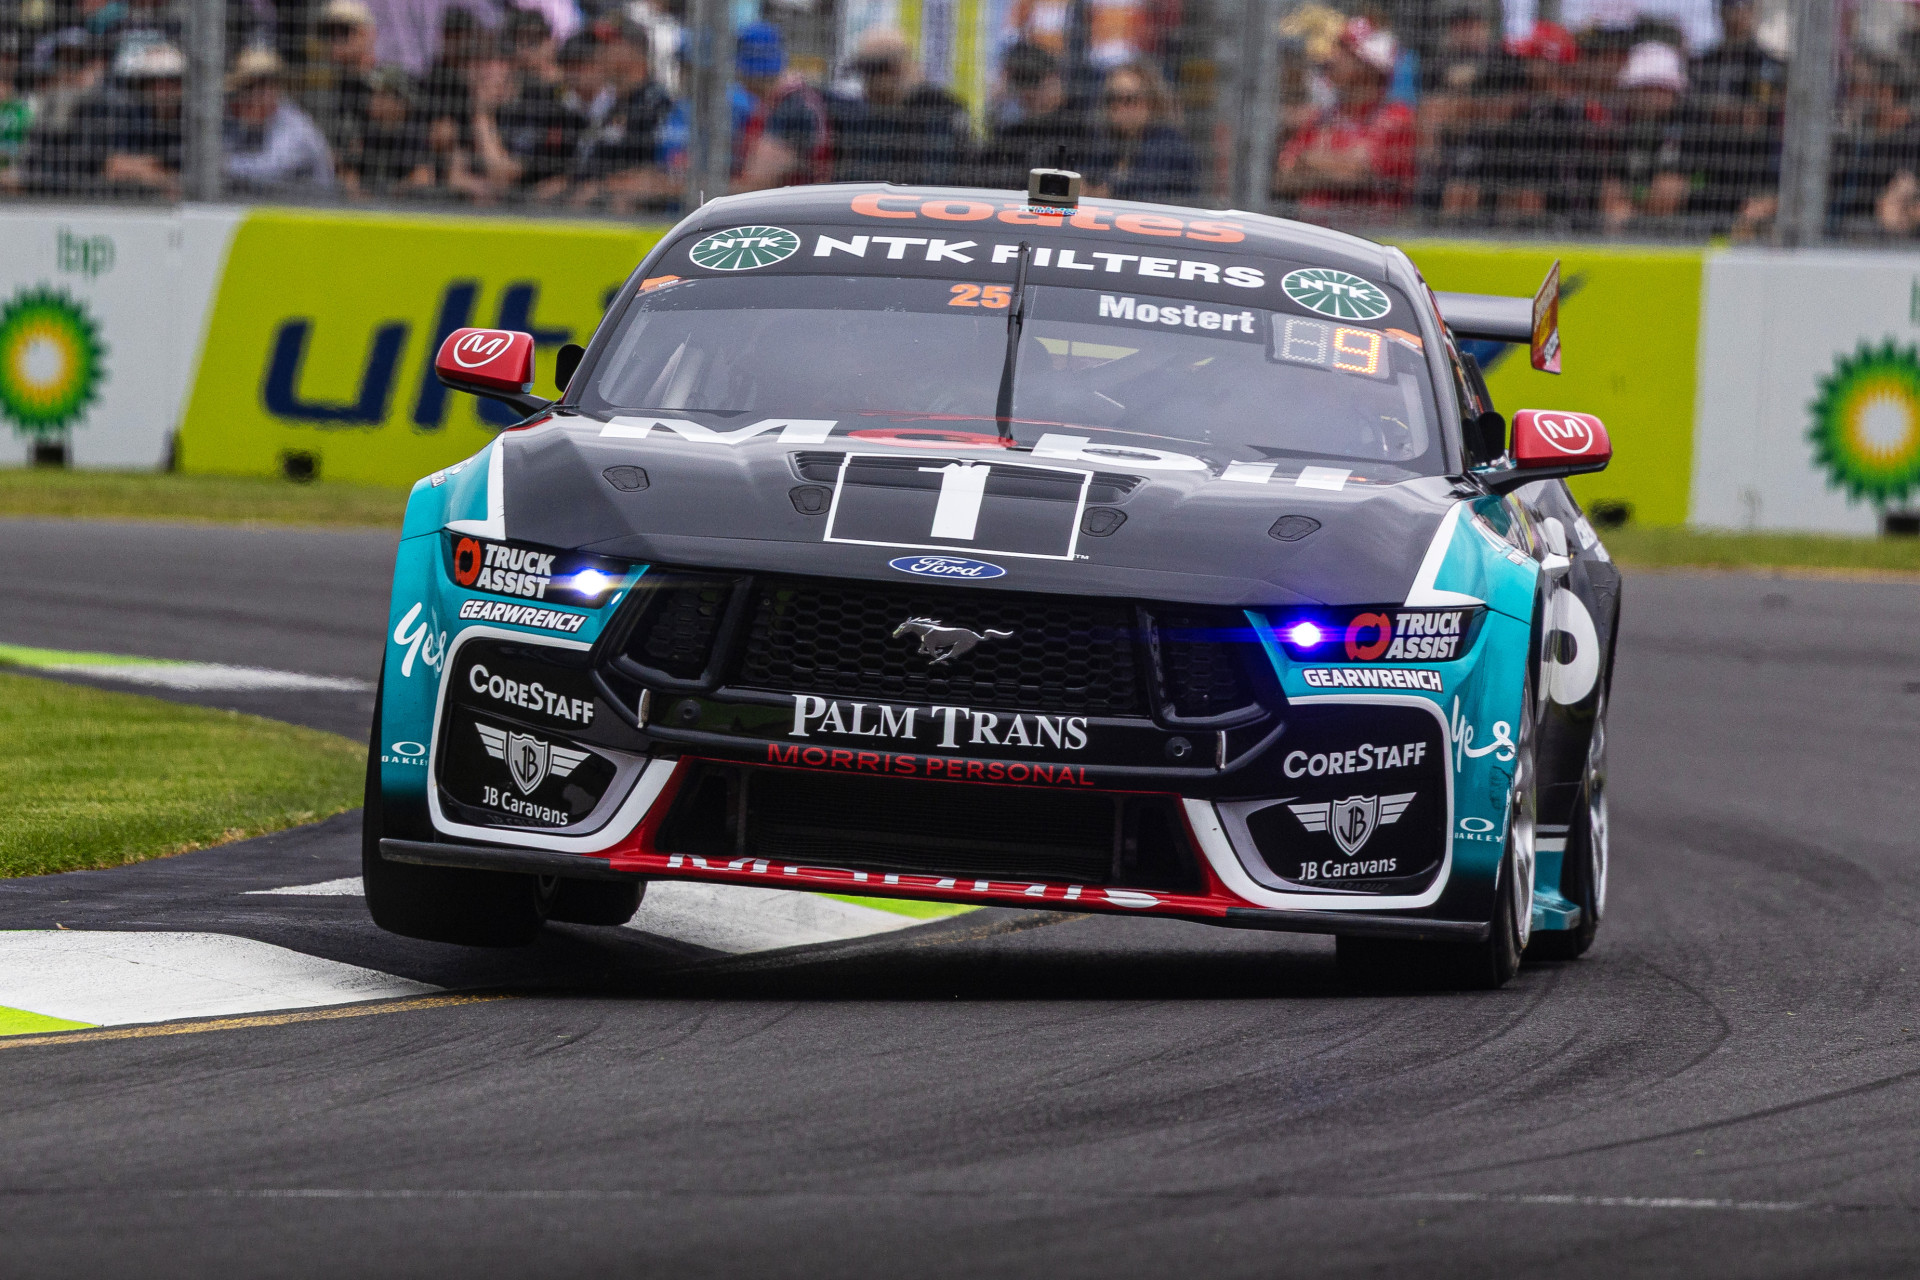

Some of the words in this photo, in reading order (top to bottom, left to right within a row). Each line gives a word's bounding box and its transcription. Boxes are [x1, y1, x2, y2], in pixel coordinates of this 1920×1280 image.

[851, 193, 1245, 243] Coates
[57, 227, 115, 277] bp
[709, 236, 784, 251] NTK
[813, 235, 978, 264] NTK
[991, 244, 1266, 288] FILTERS
[948, 284, 1012, 309] 25
[1300, 277, 1372, 301] NTK
[1099, 295, 1255, 334] Mostert
[917, 462, 991, 540] 1
[485, 543, 555, 576] TRUCK
[909, 557, 983, 578] Ford
[476, 567, 550, 599] ASSIST
[460, 600, 586, 632] GEARWRENCH
[1395, 612, 1462, 635] TRUCK
[1385, 637, 1458, 659] ASSIST
[1303, 669, 1442, 692] GEARWRENCH
[788, 694, 918, 739] PALM
[931, 706, 1088, 750] TRANS
[515, 744, 538, 783] JB
[767, 743, 917, 775] MORRIS
[926, 758, 1095, 786] PERSONAL
[483, 785, 498, 807] JB
[501, 791, 568, 826] Caravans
[1340, 806, 1367, 844] JB
[1454, 832, 1503, 843] OAKLEY
[1298, 861, 1317, 880] JB
[1322, 858, 1397, 877] Caravans
